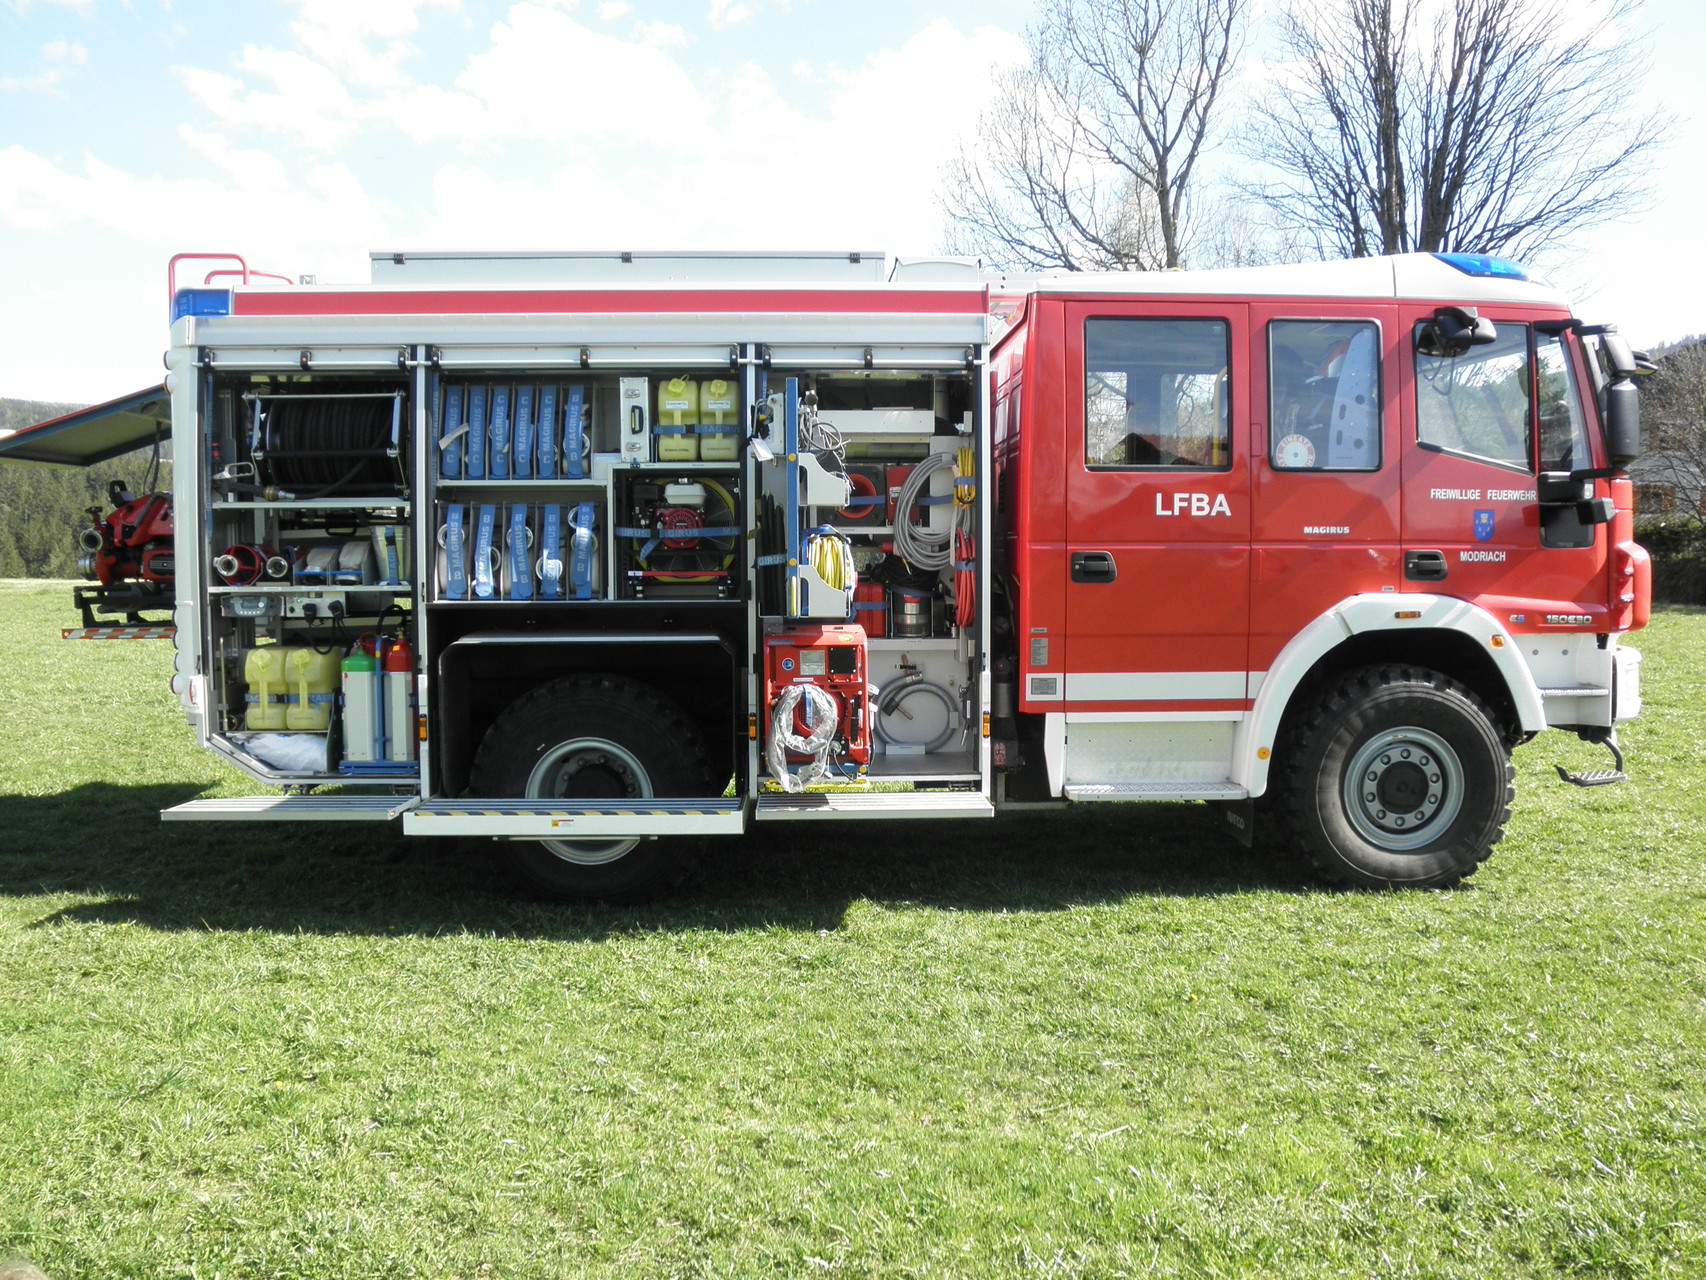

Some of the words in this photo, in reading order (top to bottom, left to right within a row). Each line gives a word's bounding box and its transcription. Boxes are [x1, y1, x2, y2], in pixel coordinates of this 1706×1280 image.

[447, 407, 458, 451] MIRUS
[472, 407, 482, 451] MAGIRUS
[495, 406, 505, 451] MAGIRUS
[518, 407, 529, 451] MAGIRUS
[542, 407, 552, 451] MAGIRUS
[569, 405, 579, 449] MAGIRUS
[702, 425, 740, 433] MAGIRU
[1155, 492, 1232, 517] LFBA
[1430, 488, 1481, 500] FREIWILLIGE
[1487, 490, 1537, 500] FEUERWEHR
[452, 521, 461, 568] MAGIRUS
[479, 525, 489, 571] MAGIRUS
[514, 524, 527, 572] MAGIRUS
[547, 525, 556, 569] MAGIRUS
[1304, 526, 1350, 534] MAGIRUS
[1460, 551, 1506, 562] MODRIACH
